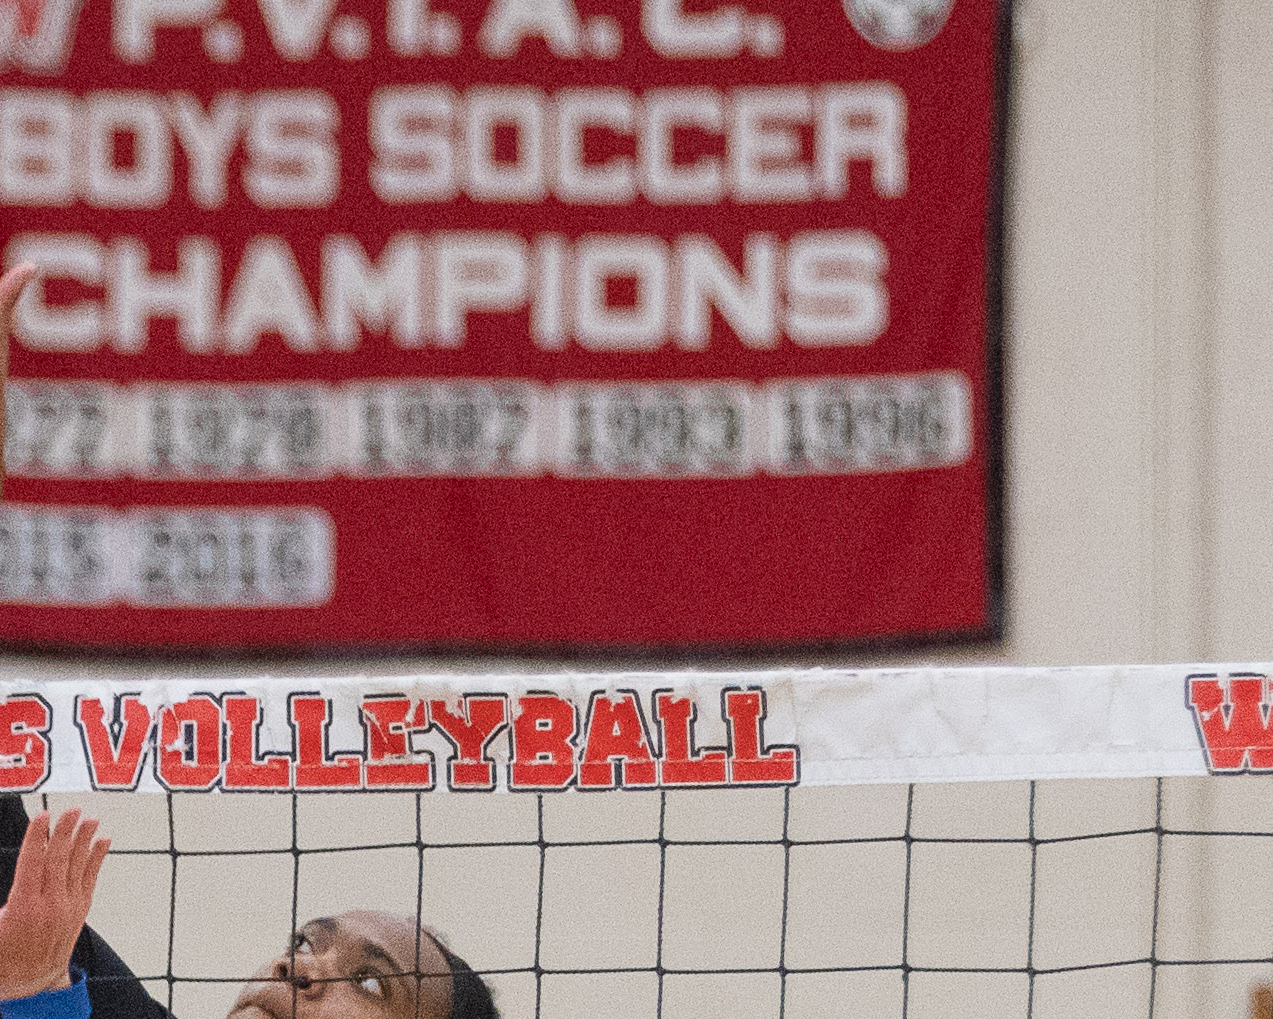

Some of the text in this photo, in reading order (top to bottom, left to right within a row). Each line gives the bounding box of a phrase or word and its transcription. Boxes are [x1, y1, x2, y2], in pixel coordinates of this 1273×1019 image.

[369, 80, 908, 204] SOCCER
[7, 229, 889, 353] CHAMPIONS
[75, 686, 801, 792] VOLLEYBALL
